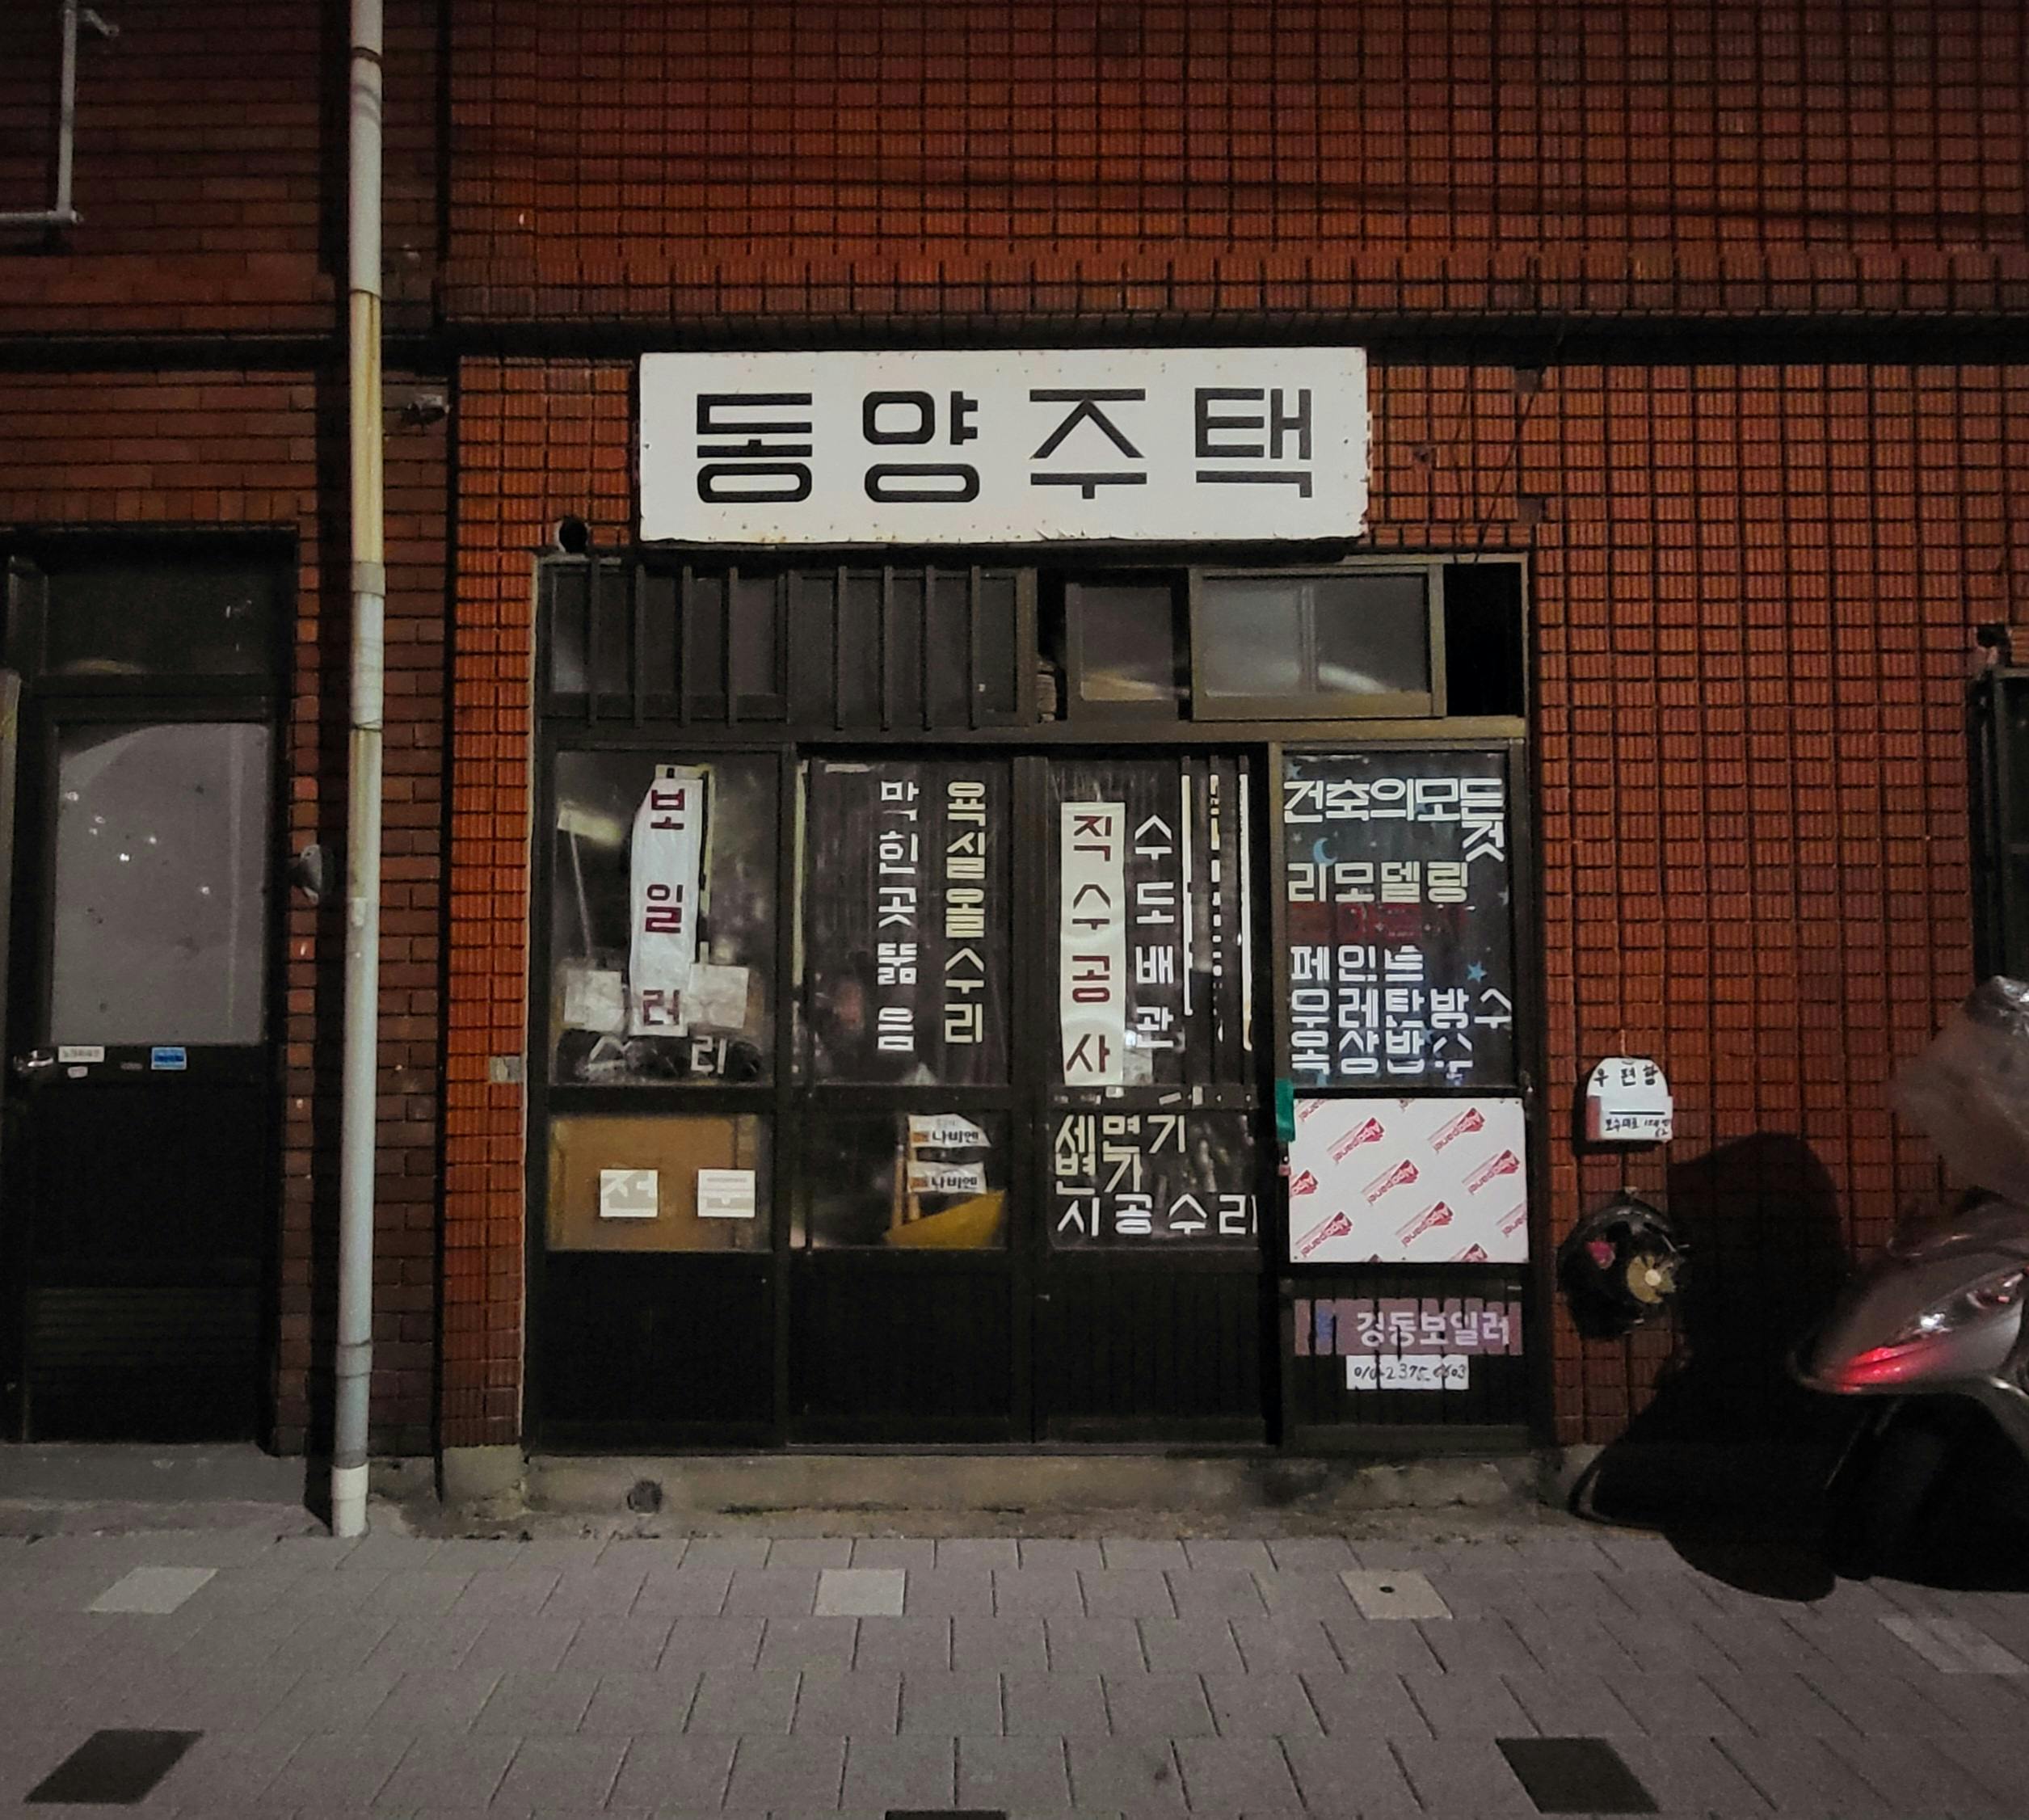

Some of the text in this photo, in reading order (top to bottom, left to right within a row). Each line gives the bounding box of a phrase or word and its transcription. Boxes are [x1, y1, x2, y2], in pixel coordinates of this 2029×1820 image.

[697, 387, 1312, 503] 동양주택
[1287, 861, 1468, 904] 리모델링
[1066, 815, 1112, 1073] 직수공사
[1134, 814, 1175, 1048] 수도배관
[1291, 988, 1513, 1030] 우레탄방수
[1593, 1064, 1659, 1088] 우편함
[932, 1130, 979, 1144] 나비엔
[1055, 1114, 1185, 1153] 세면기
[931, 1176, 978, 1189] 나비엔
[1357, 1311, 1509, 1346] 경동보일러
